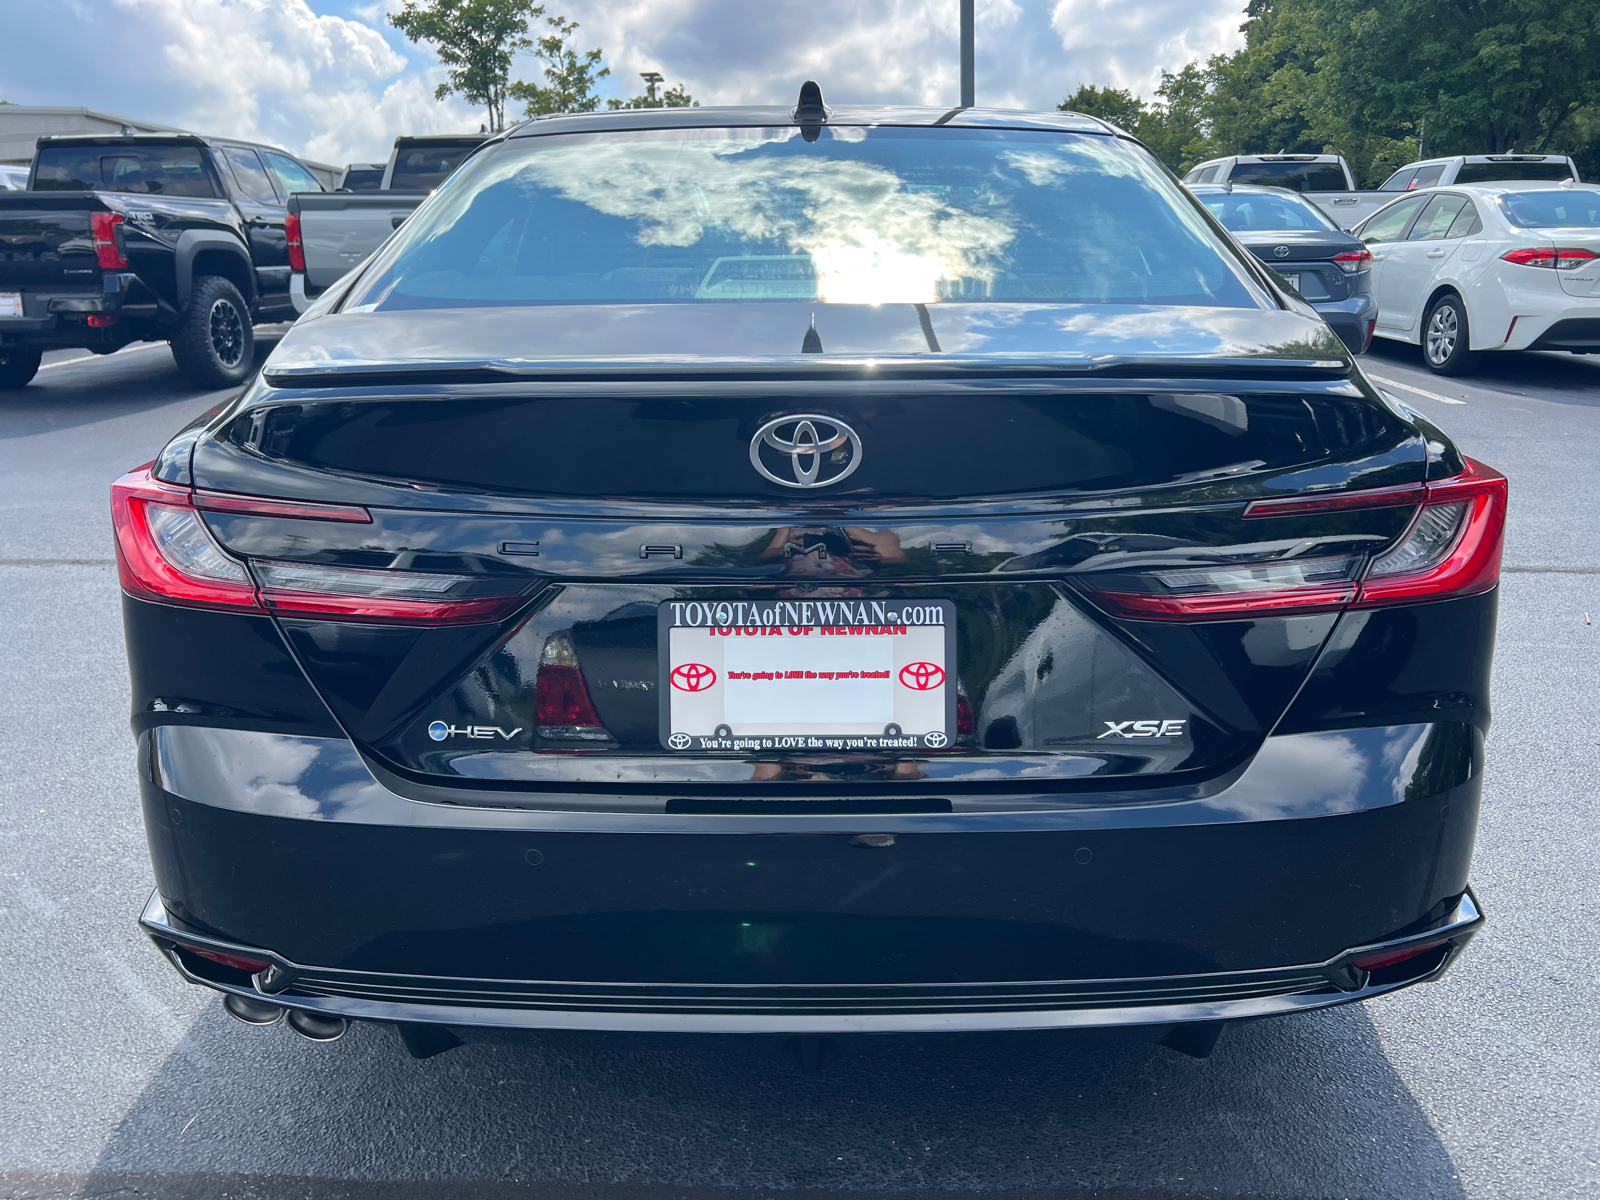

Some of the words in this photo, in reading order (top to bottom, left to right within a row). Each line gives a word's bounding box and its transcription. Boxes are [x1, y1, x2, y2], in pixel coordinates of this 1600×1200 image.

[497, 534, 1124, 560] CAMRY
[728, 671, 751, 680] You're
[752, 671, 774, 681] going
[784, 671, 803, 679] LOVE
[804, 671, 818, 679] the
[818, 672, 834, 681] way
[835, 671, 859, 680] you're
[860, 671, 891, 679] treated!
[1096, 719, 1187, 739] XSE
[700, 738, 731, 748] You're
[733, 738, 761, 750] going
[762, 738, 773, 748] to
[774, 738, 805, 748] LOVE
[807, 737, 823, 747] the
[825, 739, 844, 749] way
[845, 737, 877, 749] you're
[878, 737, 918, 747] treated!
